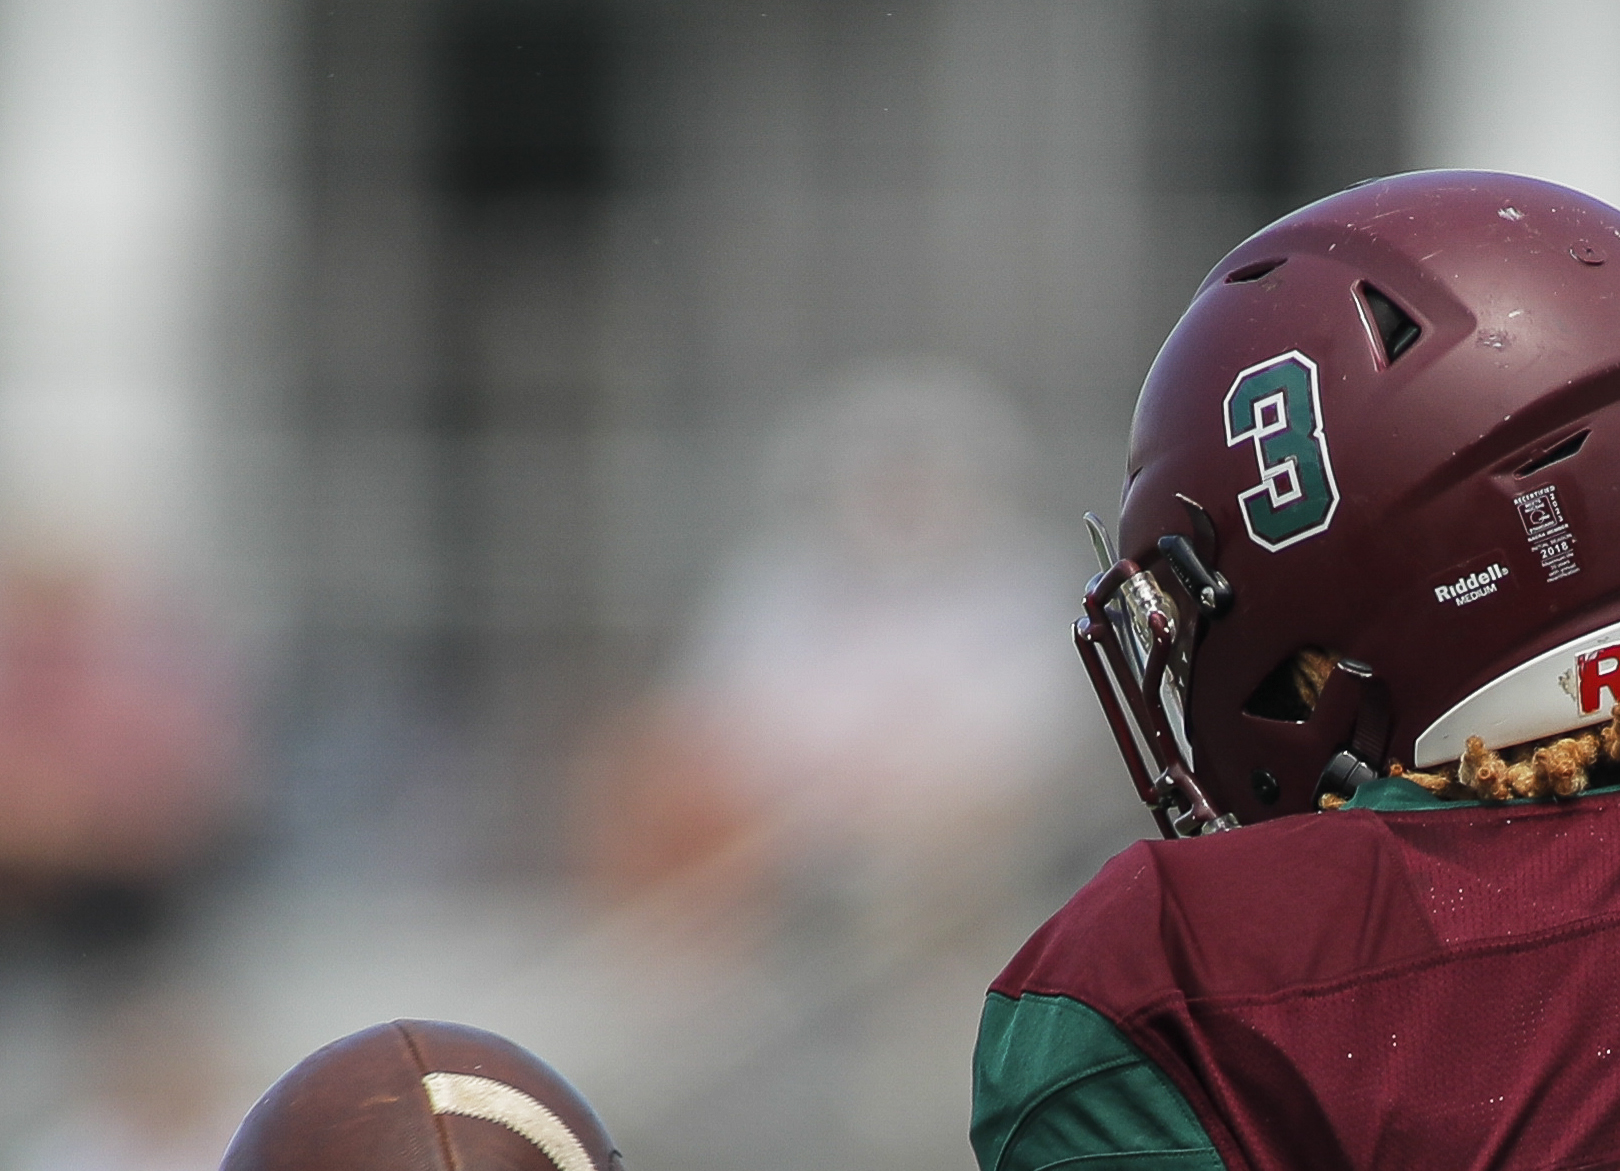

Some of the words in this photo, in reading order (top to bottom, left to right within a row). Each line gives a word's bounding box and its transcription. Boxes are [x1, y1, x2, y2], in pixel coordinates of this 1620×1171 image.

[1223, 350, 1340, 553] 3
[1540, 541, 1569, 559] 2018
[1455, 583, 1498, 607] MEDIUM
